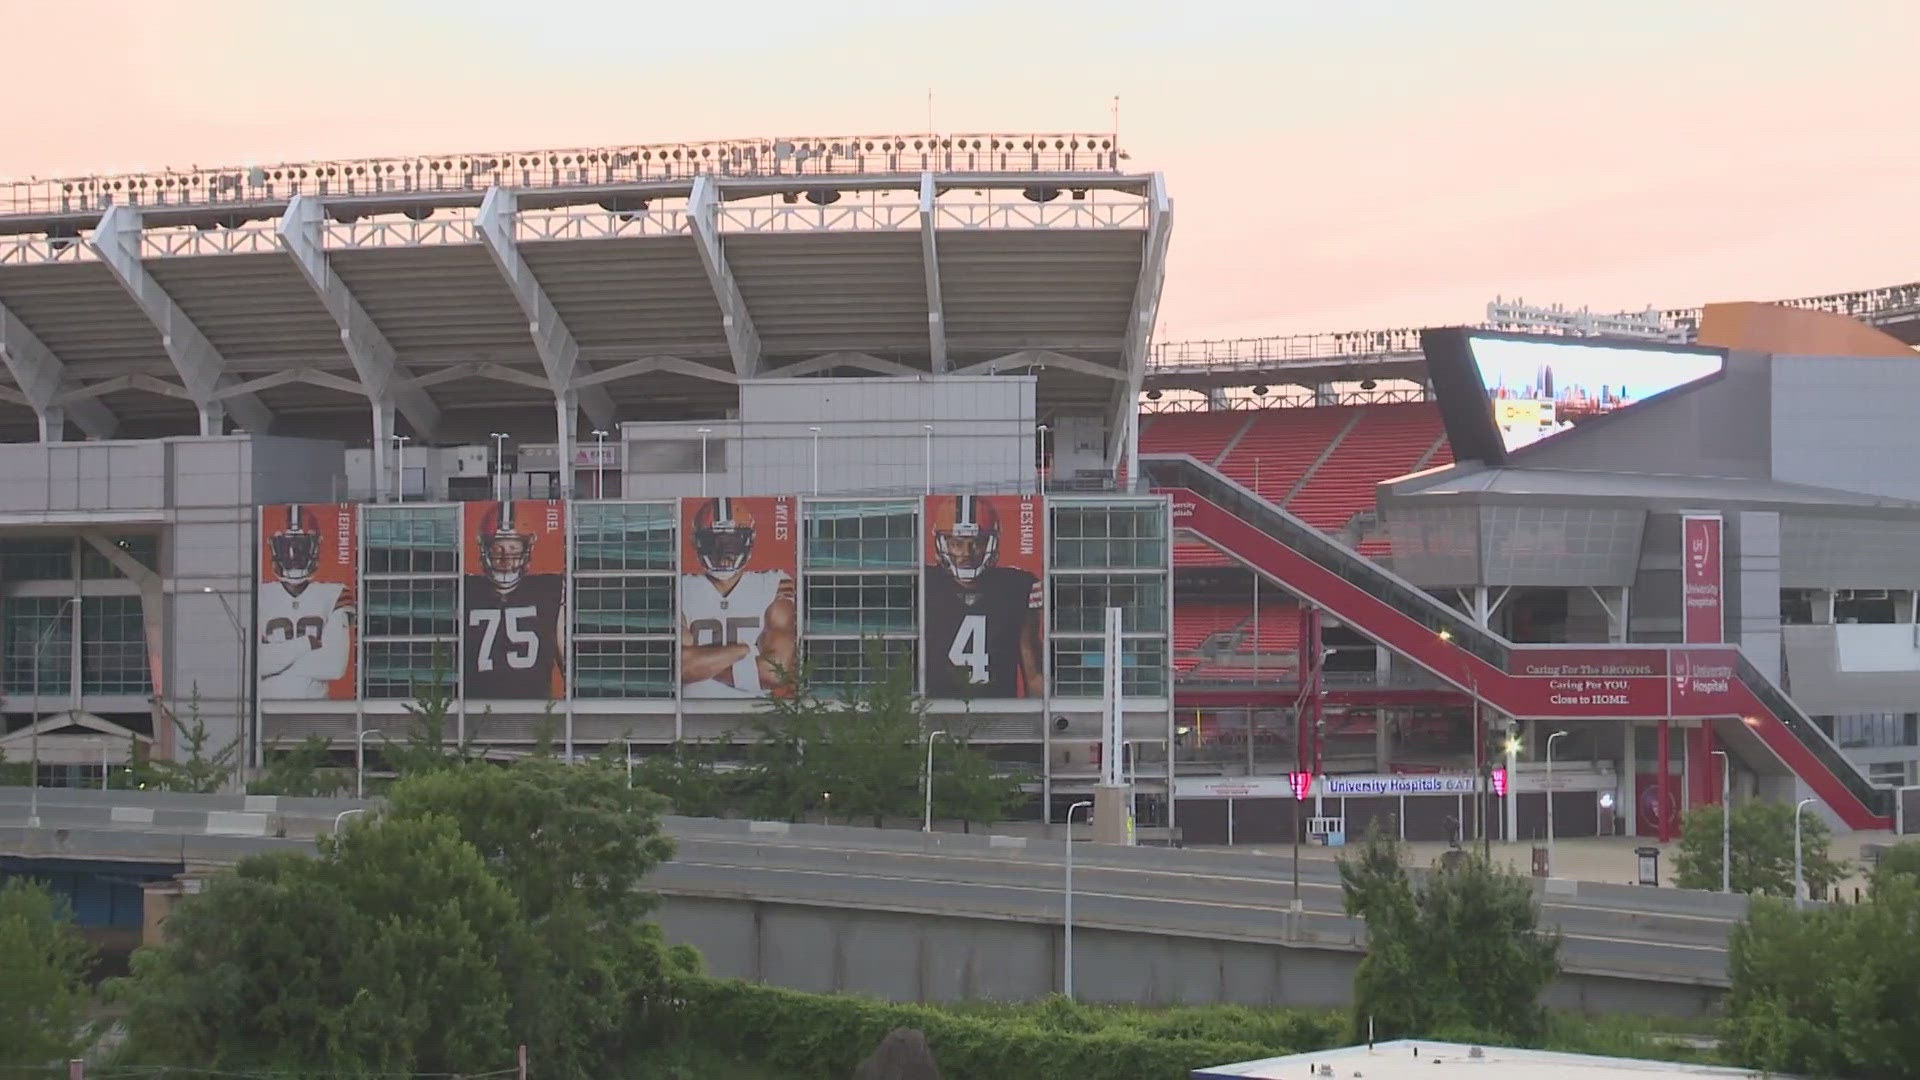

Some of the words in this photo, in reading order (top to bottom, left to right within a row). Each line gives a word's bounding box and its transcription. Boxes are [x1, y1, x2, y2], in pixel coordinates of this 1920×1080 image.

[469, 605, 539, 672] 75
[948, 614, 990, 684] 4
[1526, 665, 1560, 676] Caring
[1562, 665, 1578, 674] For
[1580, 665, 1600, 674] The
[1550, 680, 1583, 691] Caring
[1586, 680, 1602, 690] For
[1693, 679, 1728, 694] Hospitals
[1550, 694, 1578, 704] Close
[1580, 695, 1590, 704] to
[1330, 779, 1386, 794] University
[1390, 778, 1441, 793] Hospitals
